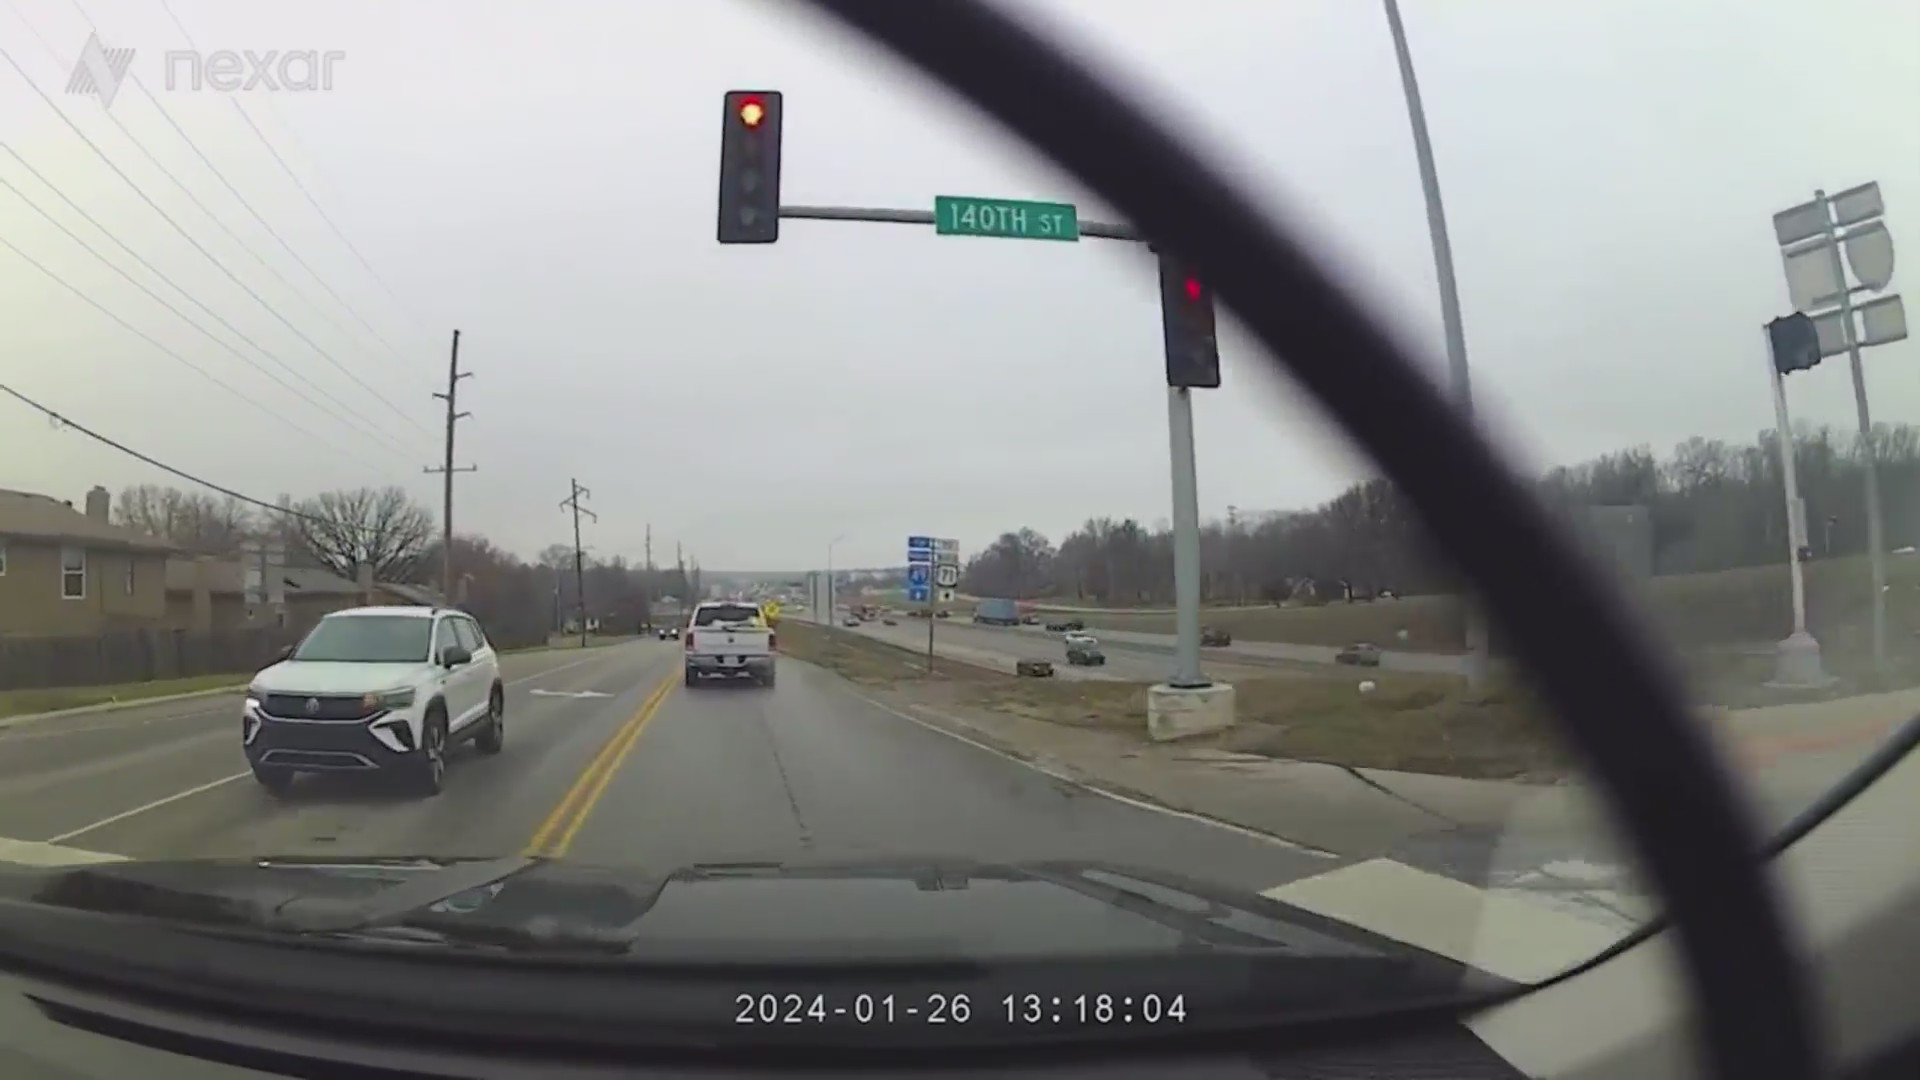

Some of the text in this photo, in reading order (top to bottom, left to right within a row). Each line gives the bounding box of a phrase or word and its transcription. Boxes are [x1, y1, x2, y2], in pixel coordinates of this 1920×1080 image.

[950, 203, 1063, 234] 140TH ST
[941, 568, 954, 582] 71
